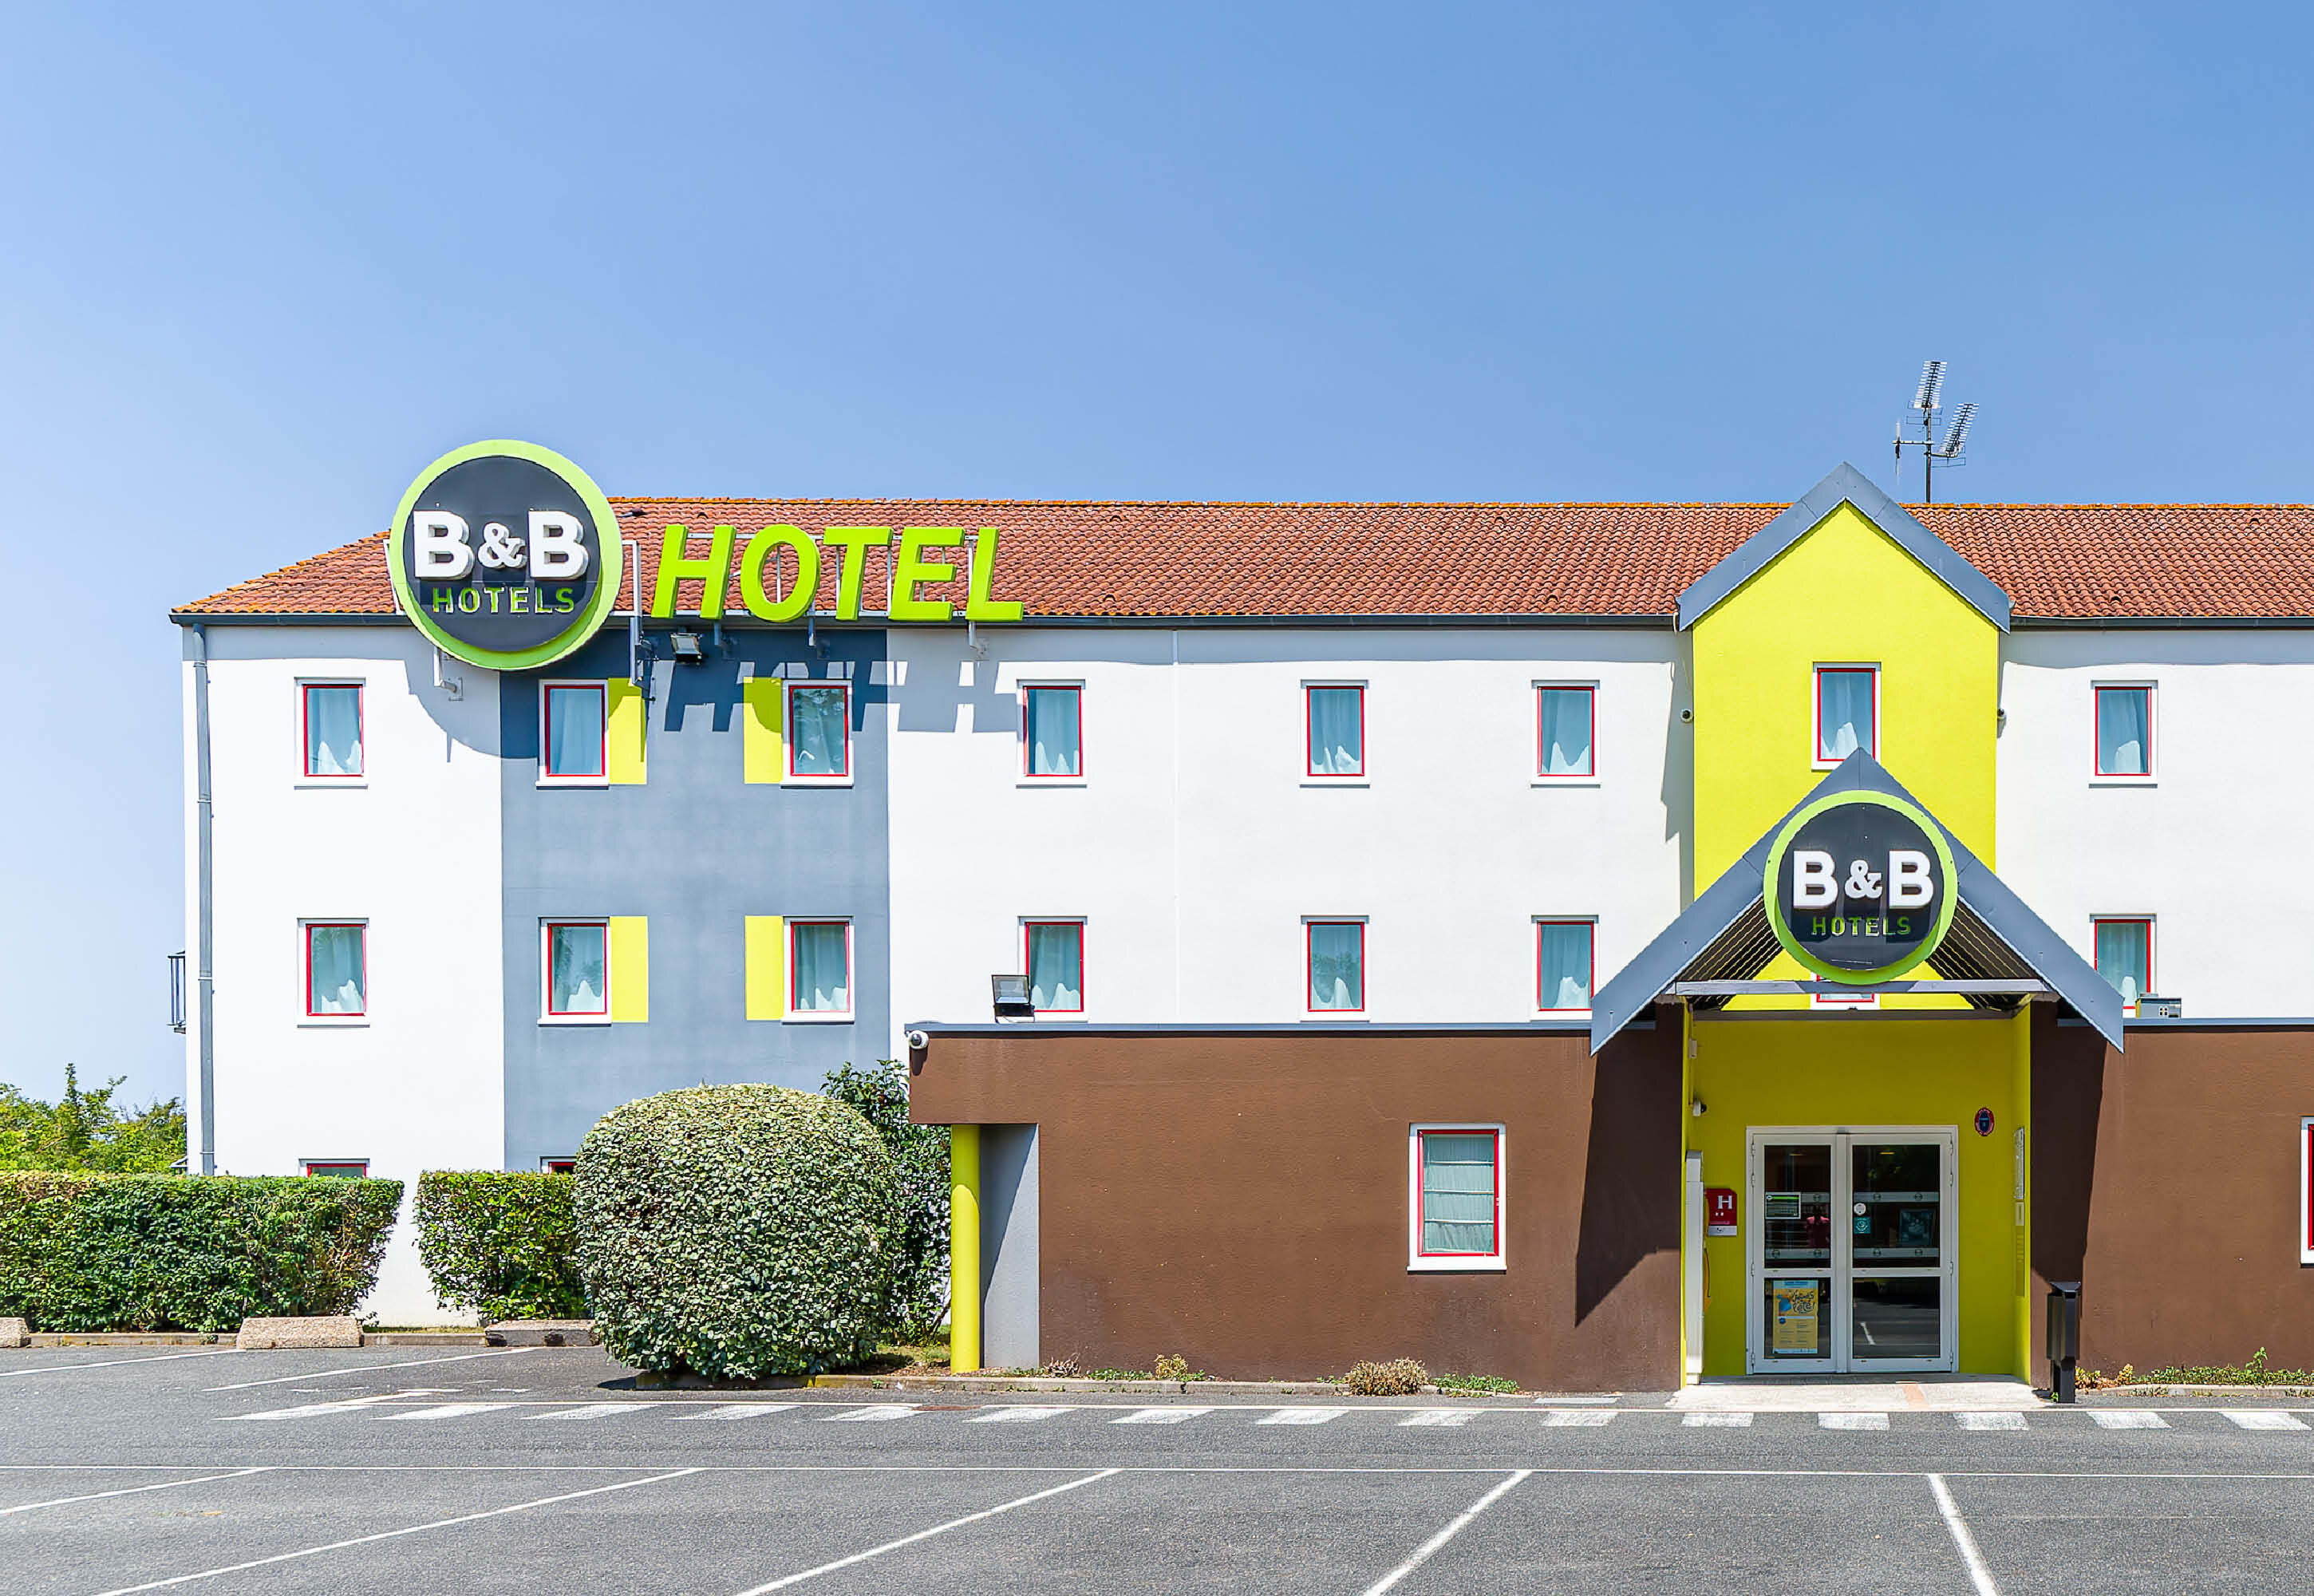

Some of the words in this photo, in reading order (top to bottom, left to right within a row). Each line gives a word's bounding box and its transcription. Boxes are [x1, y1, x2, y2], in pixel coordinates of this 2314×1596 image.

[413, 511, 589, 580] B&B
[651, 523, 1025, 622] HOTEL
[432, 587, 575, 614] HOTELS
[1793, 850, 1934, 910] B&B
[1811, 916, 1912, 936] HOTELS
[1717, 1195, 1732, 1209] H
